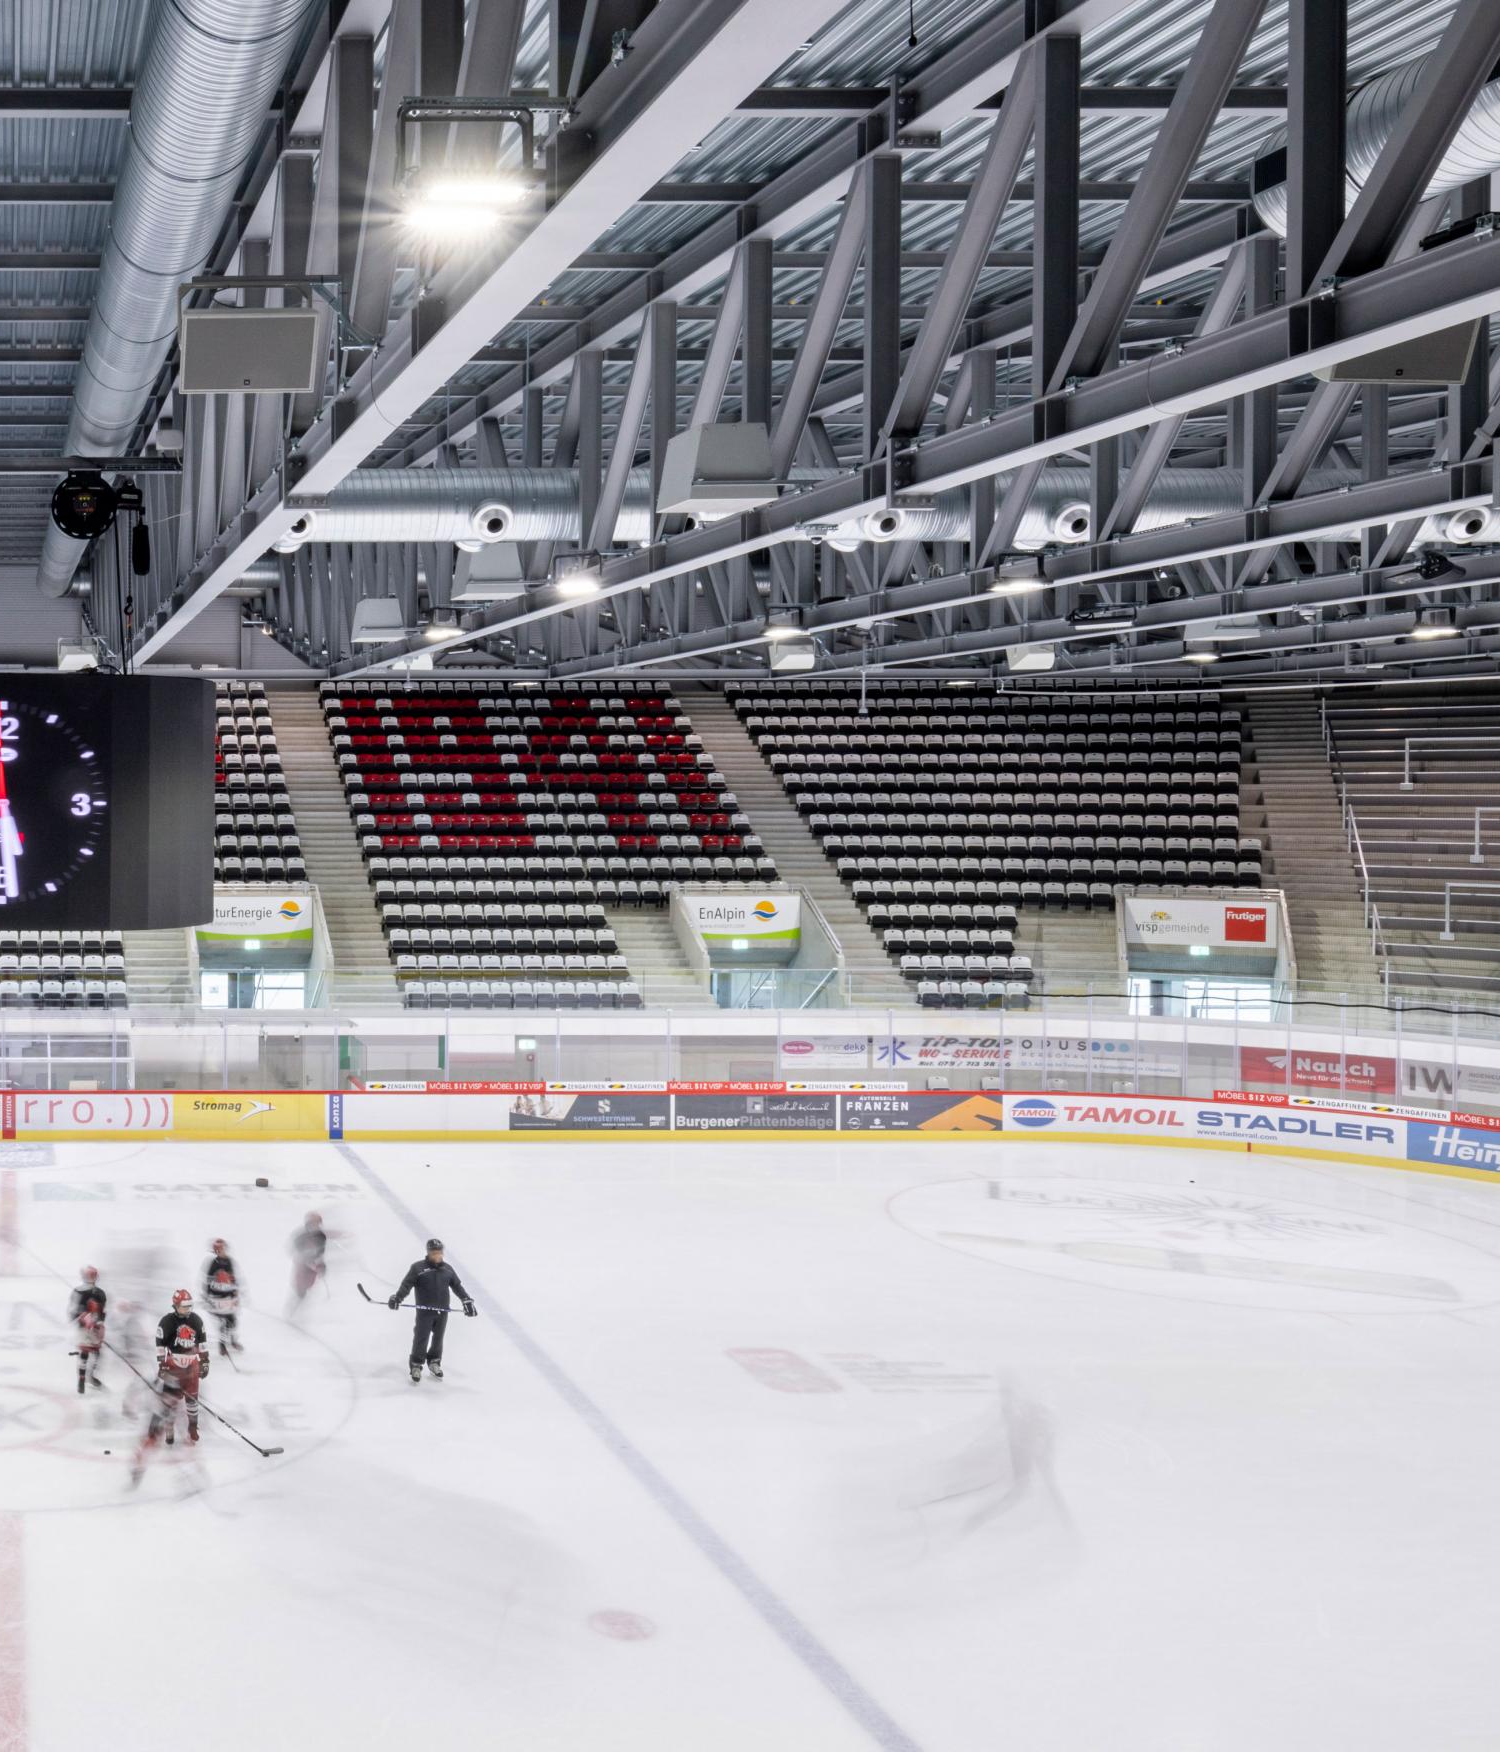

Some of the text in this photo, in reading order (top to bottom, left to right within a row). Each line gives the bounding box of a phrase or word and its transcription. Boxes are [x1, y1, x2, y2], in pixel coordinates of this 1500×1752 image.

[70, 794, 92, 816] 3
[214, 907, 272, 921] turEnergie
[700, 908, 745, 922] EnAlpin
[1227, 912, 1265, 922] Frutiger
[918, 1050, 940, 1058] WC
[1296, 1058, 1376, 1077] Nau.ch
[1218, 1092, 1246, 1101] MÖBEL
[1266, 1096, 1284, 1104] VISP
[194, 1101, 242, 1112] Stromag
[846, 1102, 909, 1111] FRANZEN
[1316, 1100, 1367, 1110] ZENGAFFINEN
[1012, 1109, 1057, 1117] TAMOIL
[1064, 1106, 1184, 1127] TAMOIL
[1396, 1109, 1447, 1119] ZENGAFFINEN
[676, 1116, 834, 1129] BurgenerPlattenbeläge
[1455, 1114, 1486, 1125] MÖBEL
[1197, 1110, 1395, 1144] STADLER
[1196, 1130, 1278, 1142] www.stadlerrail.com
